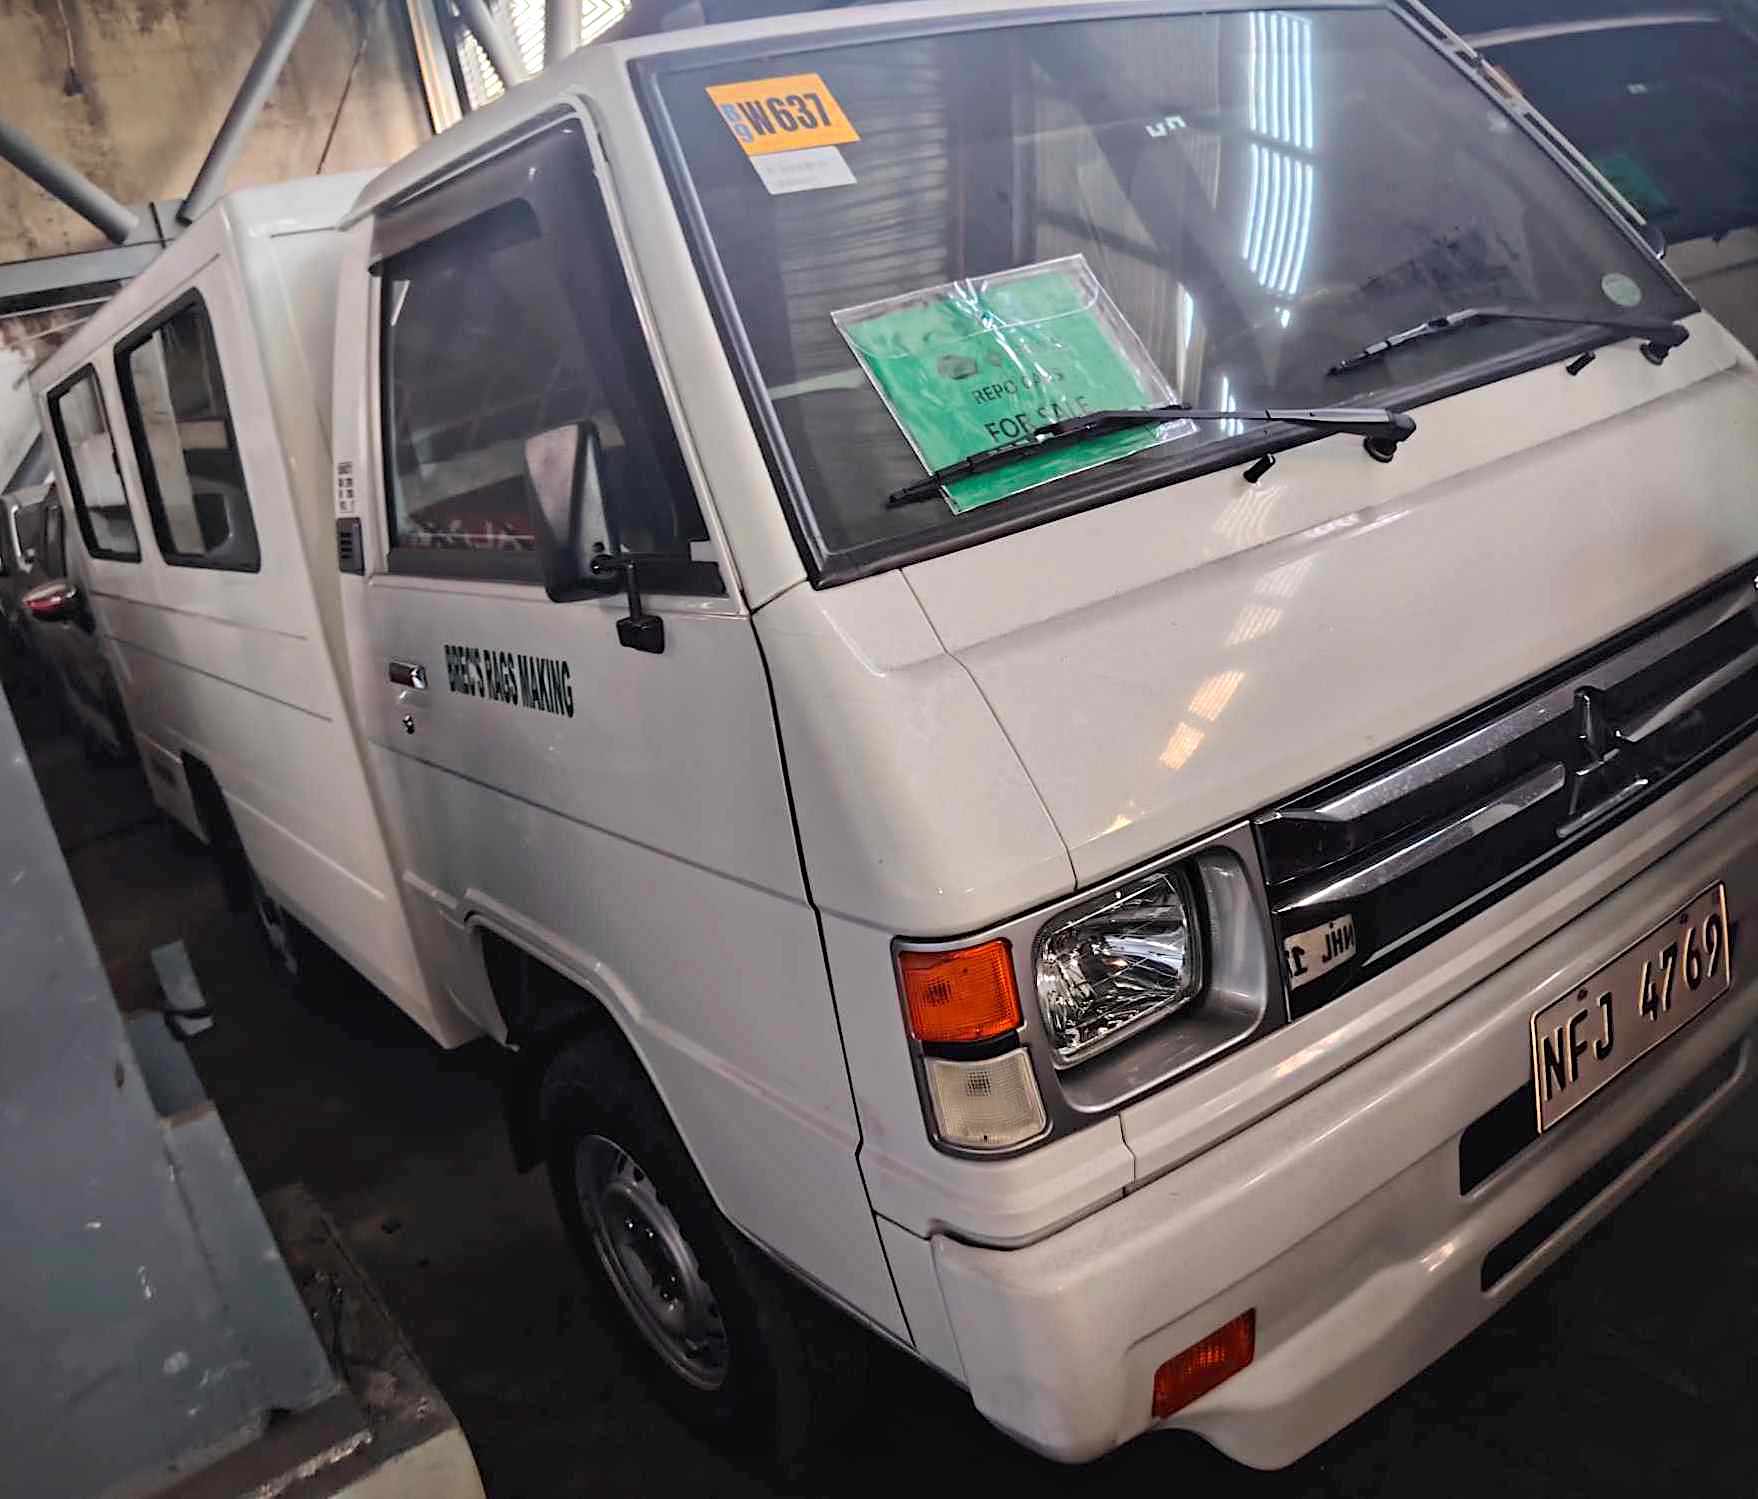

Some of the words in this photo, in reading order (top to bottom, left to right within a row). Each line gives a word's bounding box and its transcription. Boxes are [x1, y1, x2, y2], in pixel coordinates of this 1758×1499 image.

[736, 92, 832, 136] W637
[971, 379, 1018, 405] REPO
[483, 649, 519, 706] RAGS
[517, 654, 574, 718] MAKING
[1541, 991, 1614, 1102] NFJ
[1637, 913, 1722, 1022] 4769
